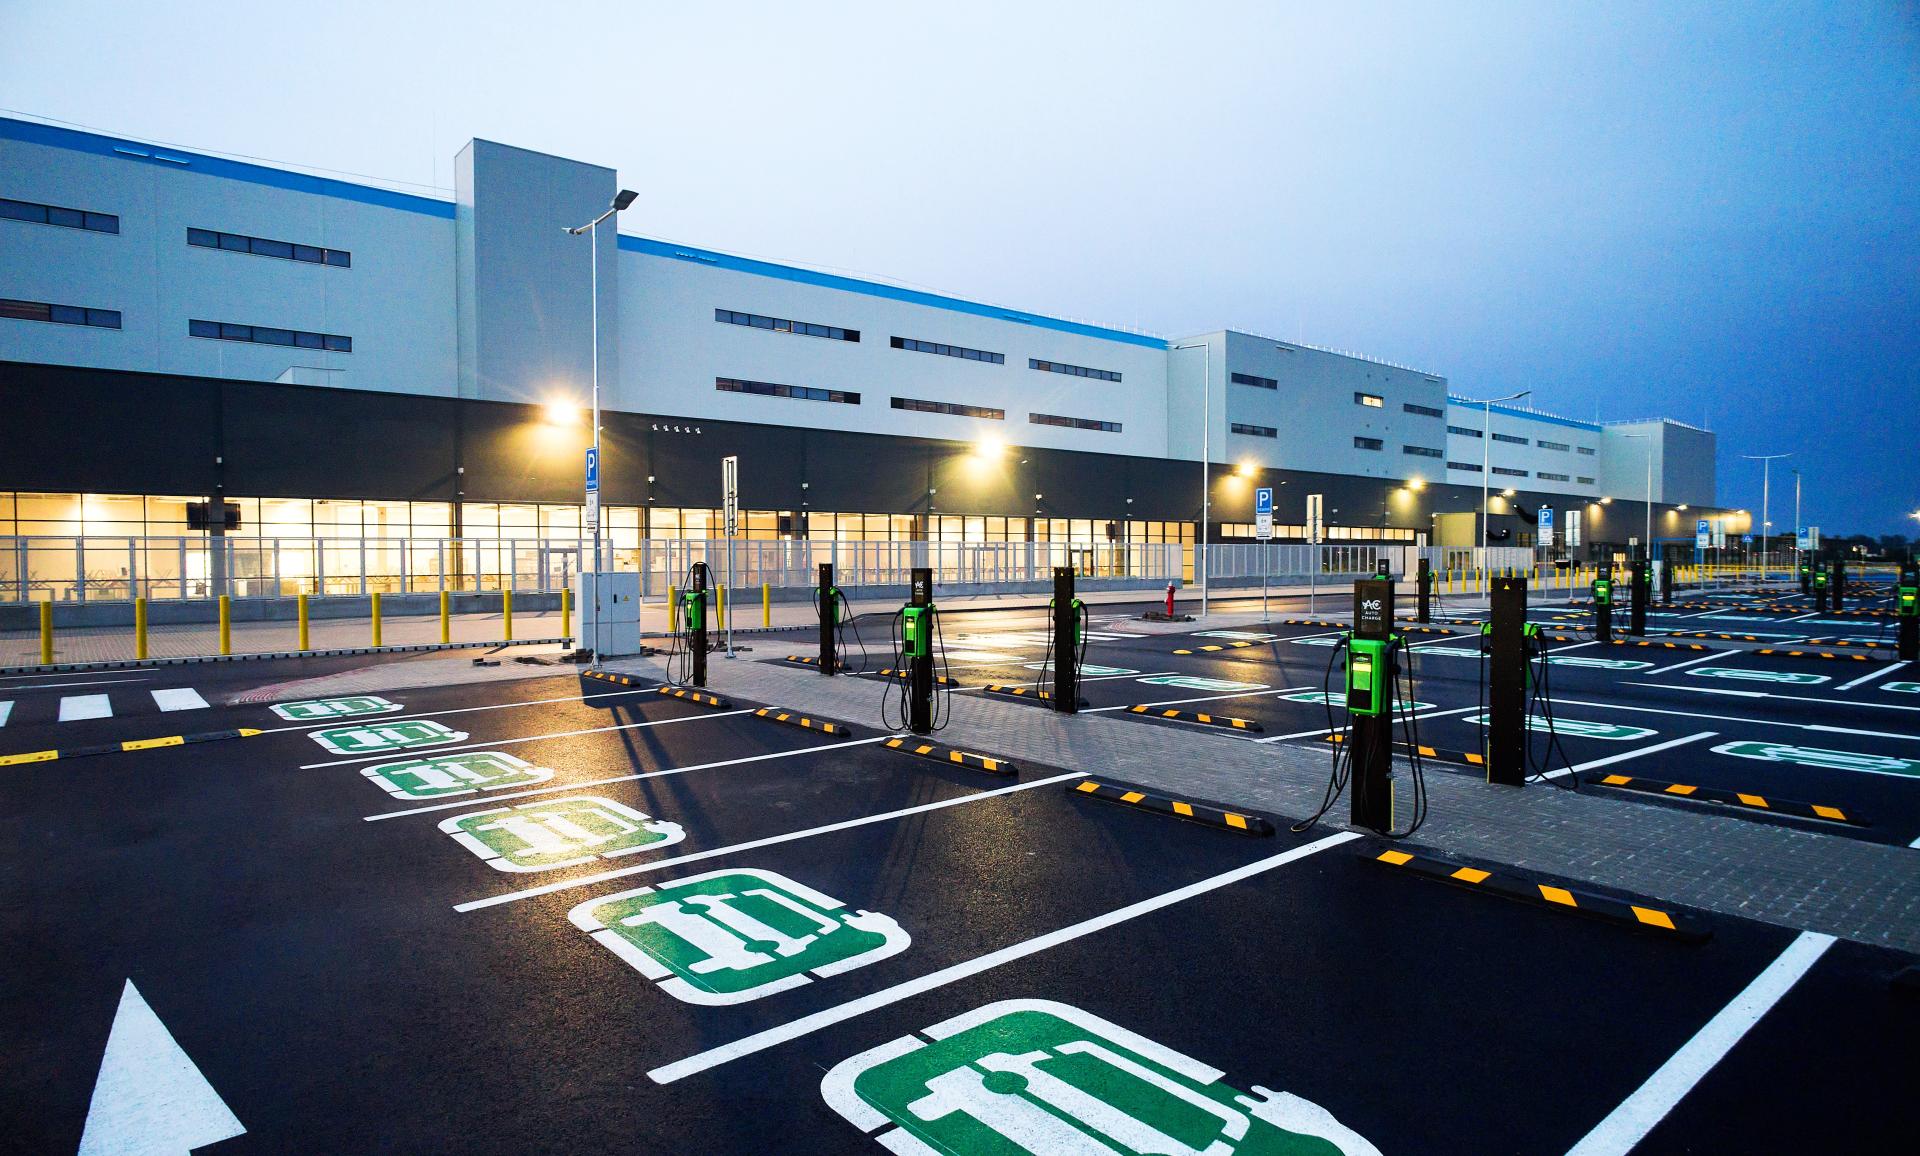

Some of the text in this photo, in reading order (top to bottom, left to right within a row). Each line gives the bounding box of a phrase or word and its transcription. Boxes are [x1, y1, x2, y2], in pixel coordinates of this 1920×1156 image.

[588, 453, 595, 477] P
[1259, 491, 1269, 507] P
[1541, 511, 1550, 522] P
[1699, 521, 1707, 531] P
[1799, 527, 1806, 536] P
